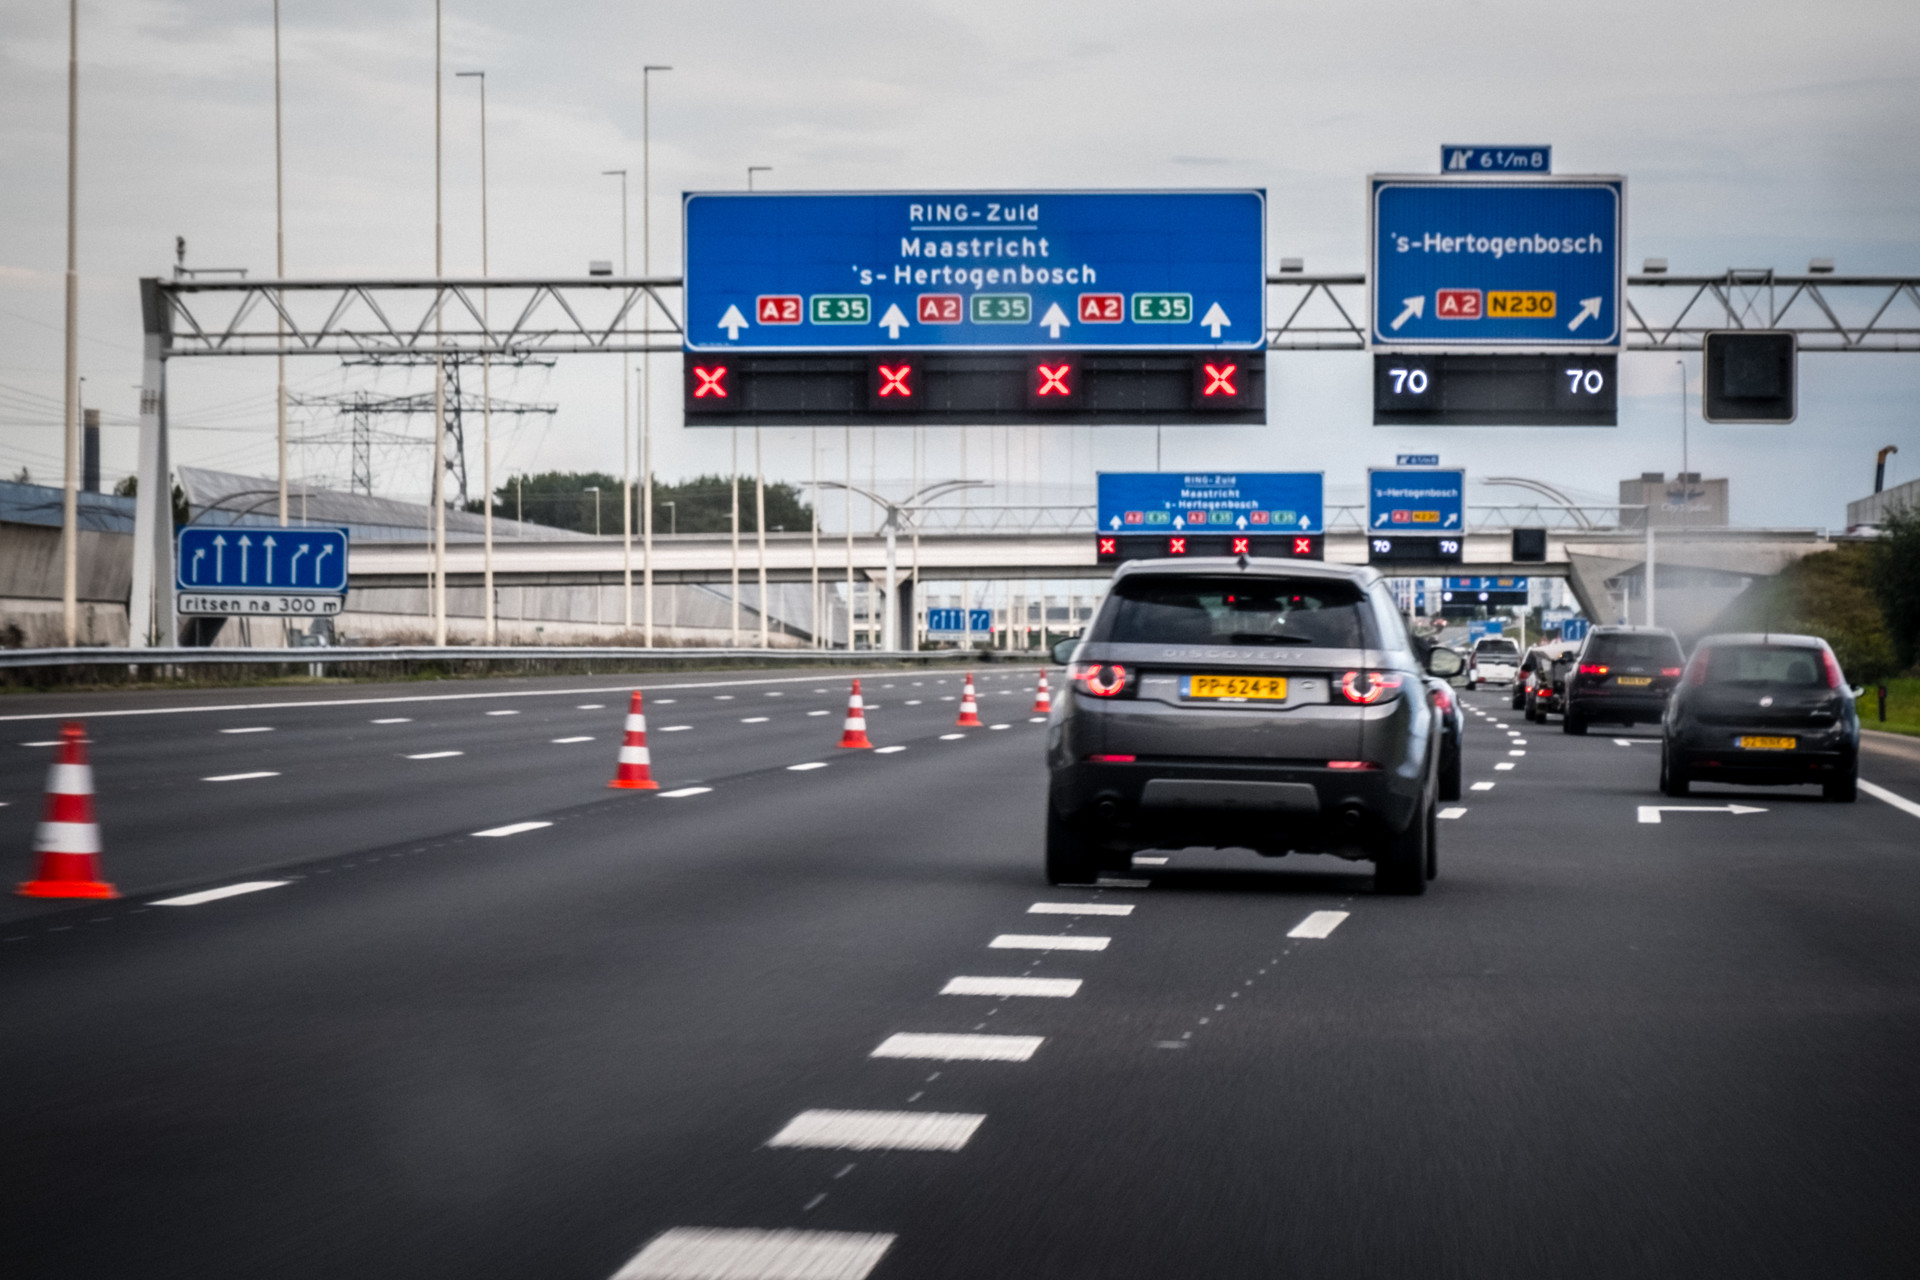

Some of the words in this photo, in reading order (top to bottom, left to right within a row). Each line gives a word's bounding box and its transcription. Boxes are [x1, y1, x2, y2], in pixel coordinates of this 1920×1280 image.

[909, 203, 1039, 222] RING-Zuid
[901, 236, 1050, 258] Maastricht
[1391, 232, 1603, 259] 's-Hertogenbosch
[762, 301, 798, 319] A2
[924, 300, 957, 318] A2
[1084, 299, 1119, 318] A2
[1442, 295, 1477, 314] A2
[1492, 296, 1553, 313] N230
[1389, 369, 1428, 394] 70
[1566, 369, 1604, 394] 70
[1181, 489, 1240, 499] Maastricht
[1373, 540, 1391, 553] 70
[1441, 540, 1458, 553] 70
[185, 598, 241, 611] ritsen
[249, 601, 271, 612] na
[278, 599, 316, 612] 300
[323, 602, 337, 612] m
[1197, 678, 1280, 696] PP-624-R
